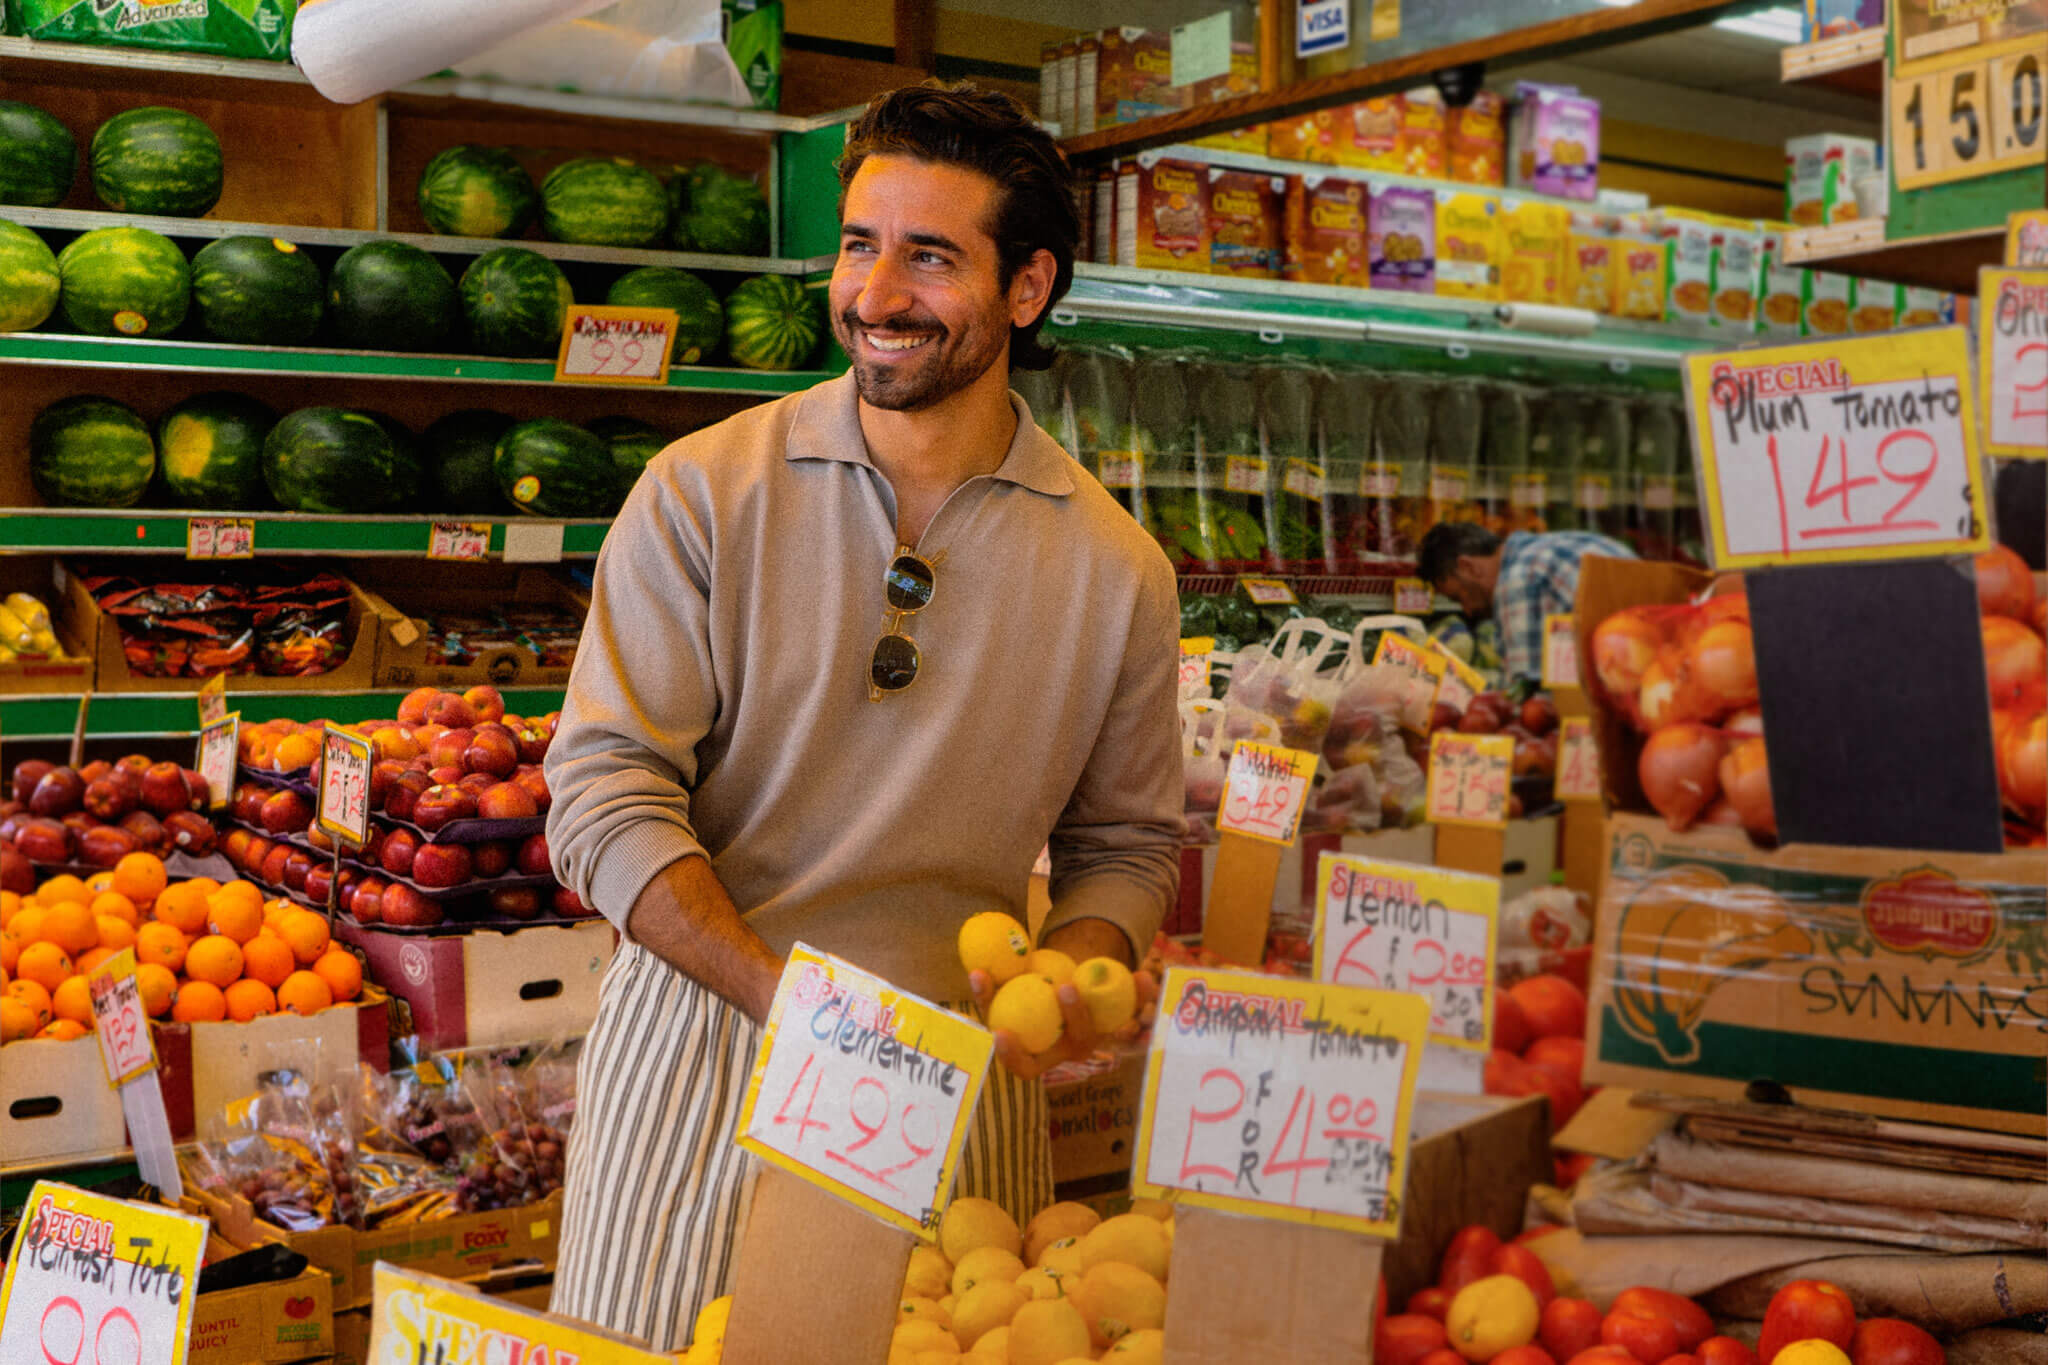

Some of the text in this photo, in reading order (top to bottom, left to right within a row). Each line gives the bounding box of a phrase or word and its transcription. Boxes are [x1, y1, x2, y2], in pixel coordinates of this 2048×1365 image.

[117, 1, 206, 30] Advanced
[1306, 7, 1343, 33] VISA
[591, 338, 644, 376] 99
[1712, 374, 1809, 444] Plum
[1343, 869, 1449, 940] Lemon
[811, 995, 957, 1097] Clementine
[463, 1229, 509, 1249] FOXY
[199, 1318, 240, 1335] UNTIL
